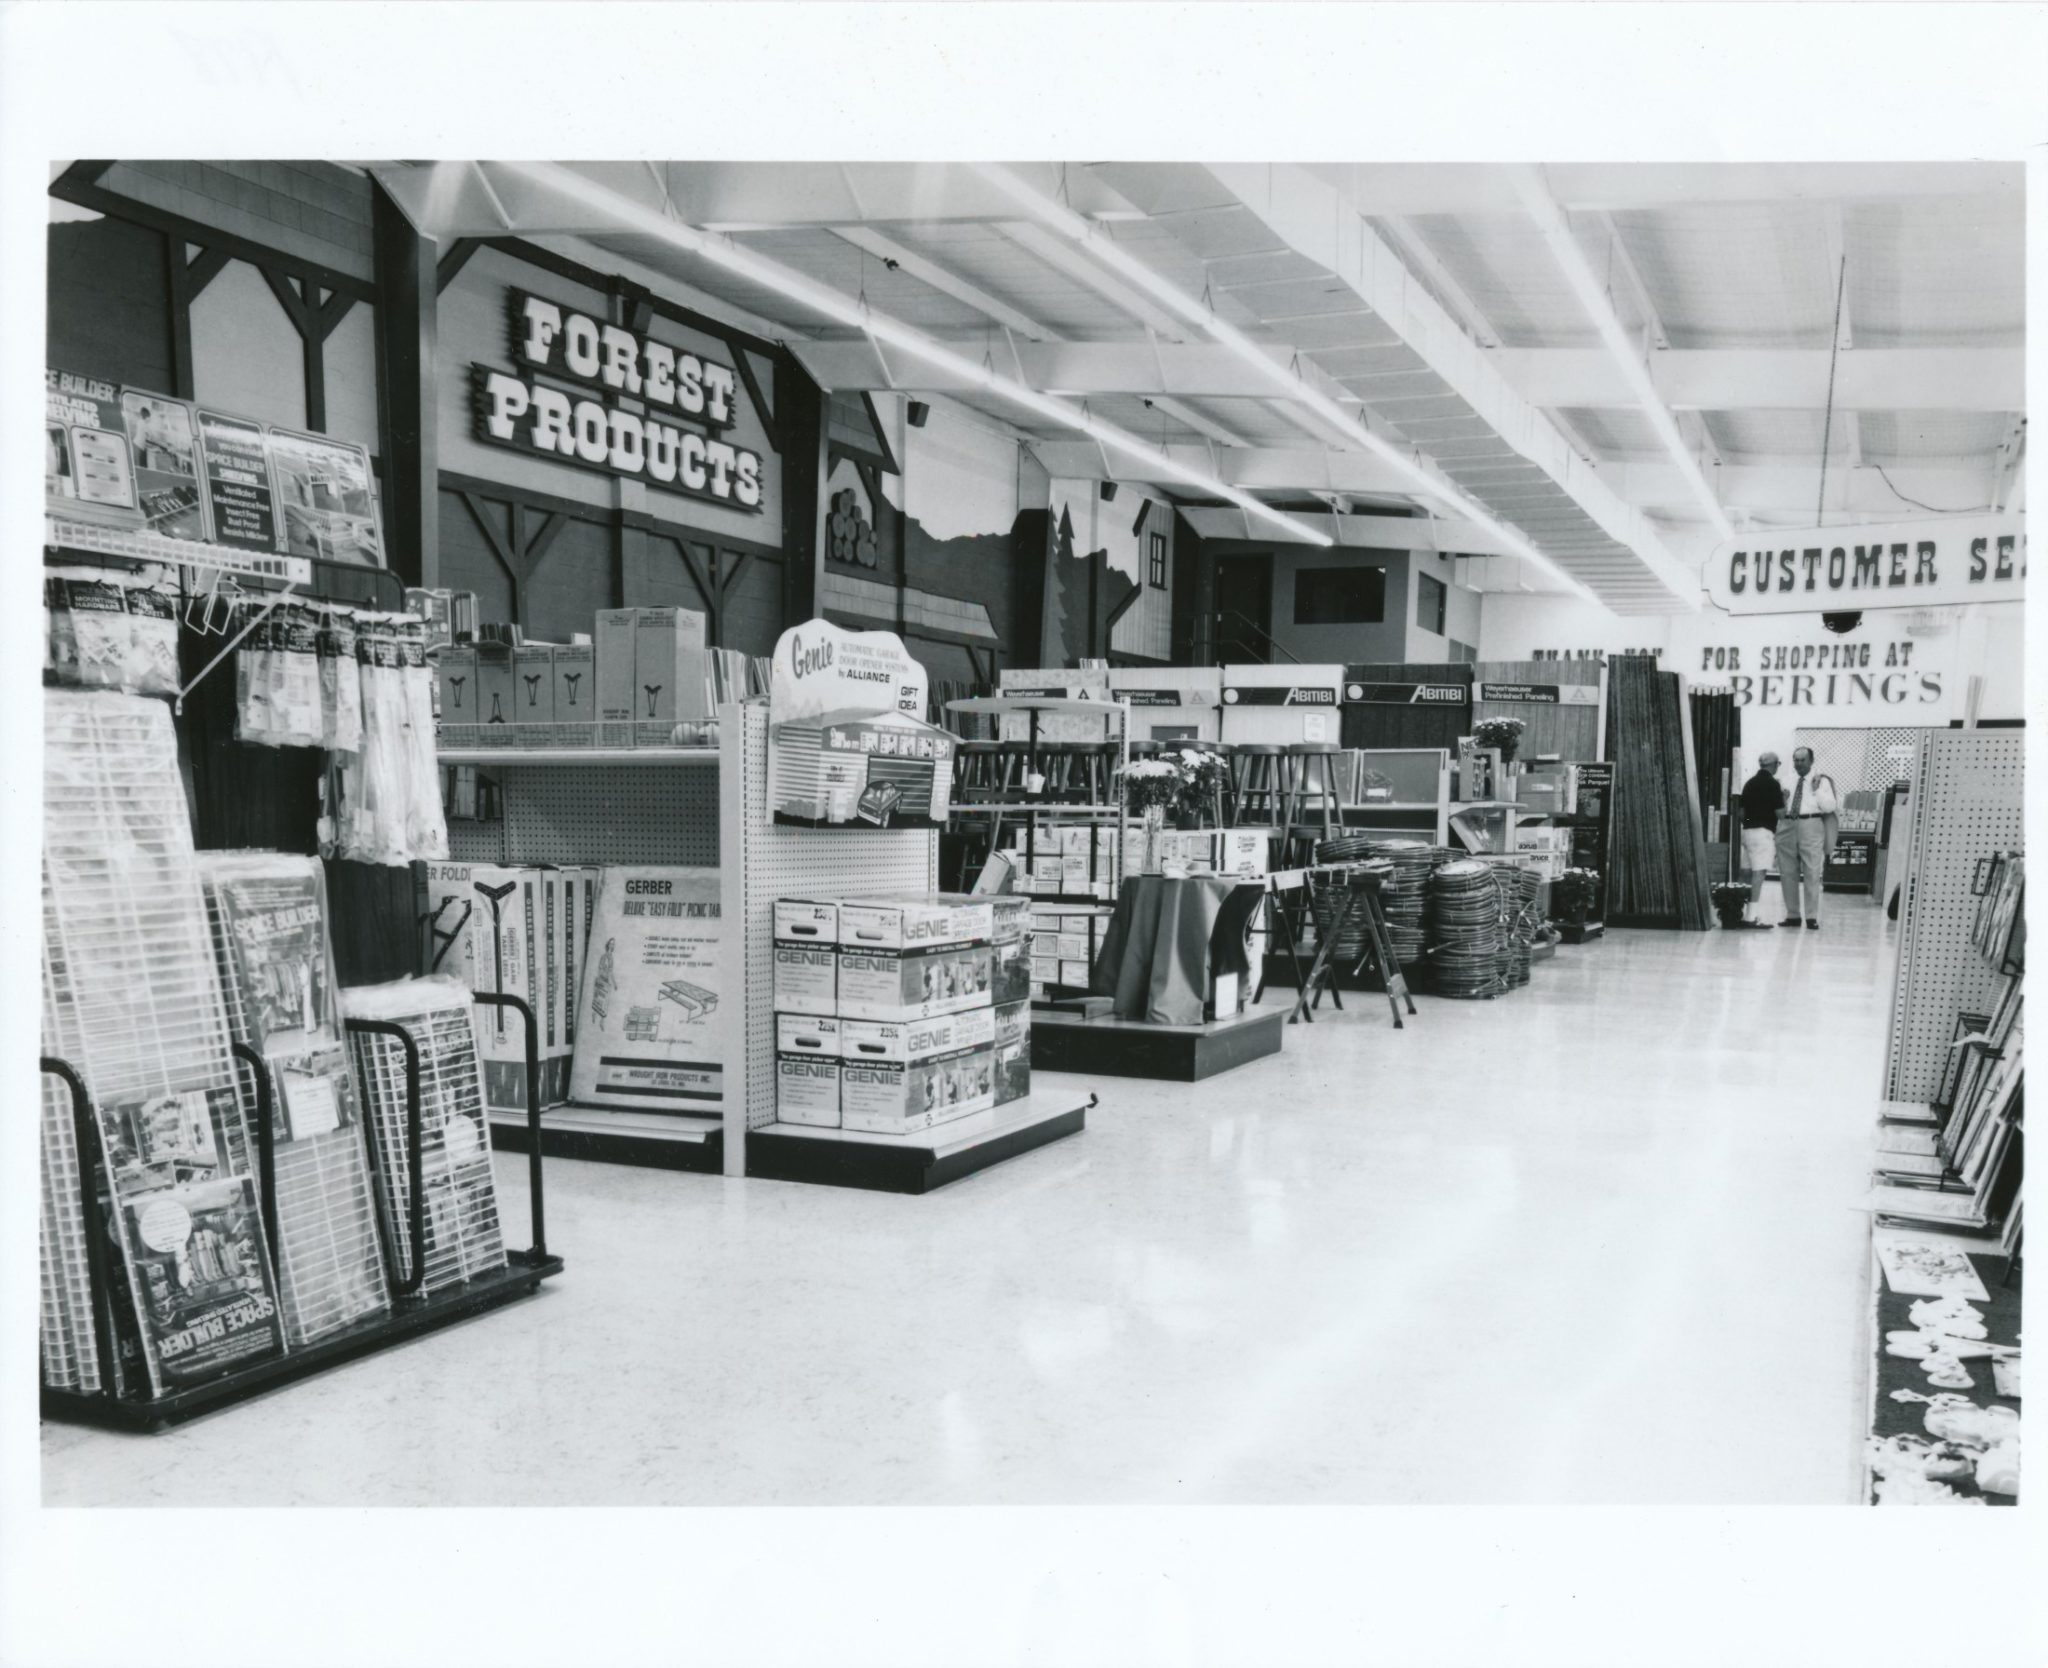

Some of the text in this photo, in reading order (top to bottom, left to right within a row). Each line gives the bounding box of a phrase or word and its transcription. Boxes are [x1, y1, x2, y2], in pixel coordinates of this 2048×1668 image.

[523, 297, 735, 422] FOREST
[61, 372, 114, 403] BUILDER
[486, 372, 760, 506] PRODUCTS
[1729, 534, 2026, 594] CUSTOMER SE
[792, 633, 833, 680] Genie
[1702, 642, 1913, 671] FOR SHOPPING AT
[847, 669, 891, 683] ALLIANCE
[900, 686, 919, 697] GIFT
[1484, 685, 1533, 695] Weyerhaeuser
[1485, 692, 1554, 702] Prefinished Paneling
[1729, 671, 1942, 707] BERING'S
[898, 699, 917, 711] IDEA
[625, 880, 672, 895] GERBER
[274, 904, 321, 930] BUILDER
[624, 901, 646, 916] DELUXE
[905, 918, 949, 940] GENIE
[776, 950, 833, 967] GENIE
[841, 956, 899, 973] GENIE
[908, 1027, 951, 1052] GENIE
[781, 1062, 837, 1080] GENIE
[844, 1069, 902, 1086] GENIE
[225, 1297, 275, 1332] SPACE
[158, 1317, 226, 1358] BUILDER
